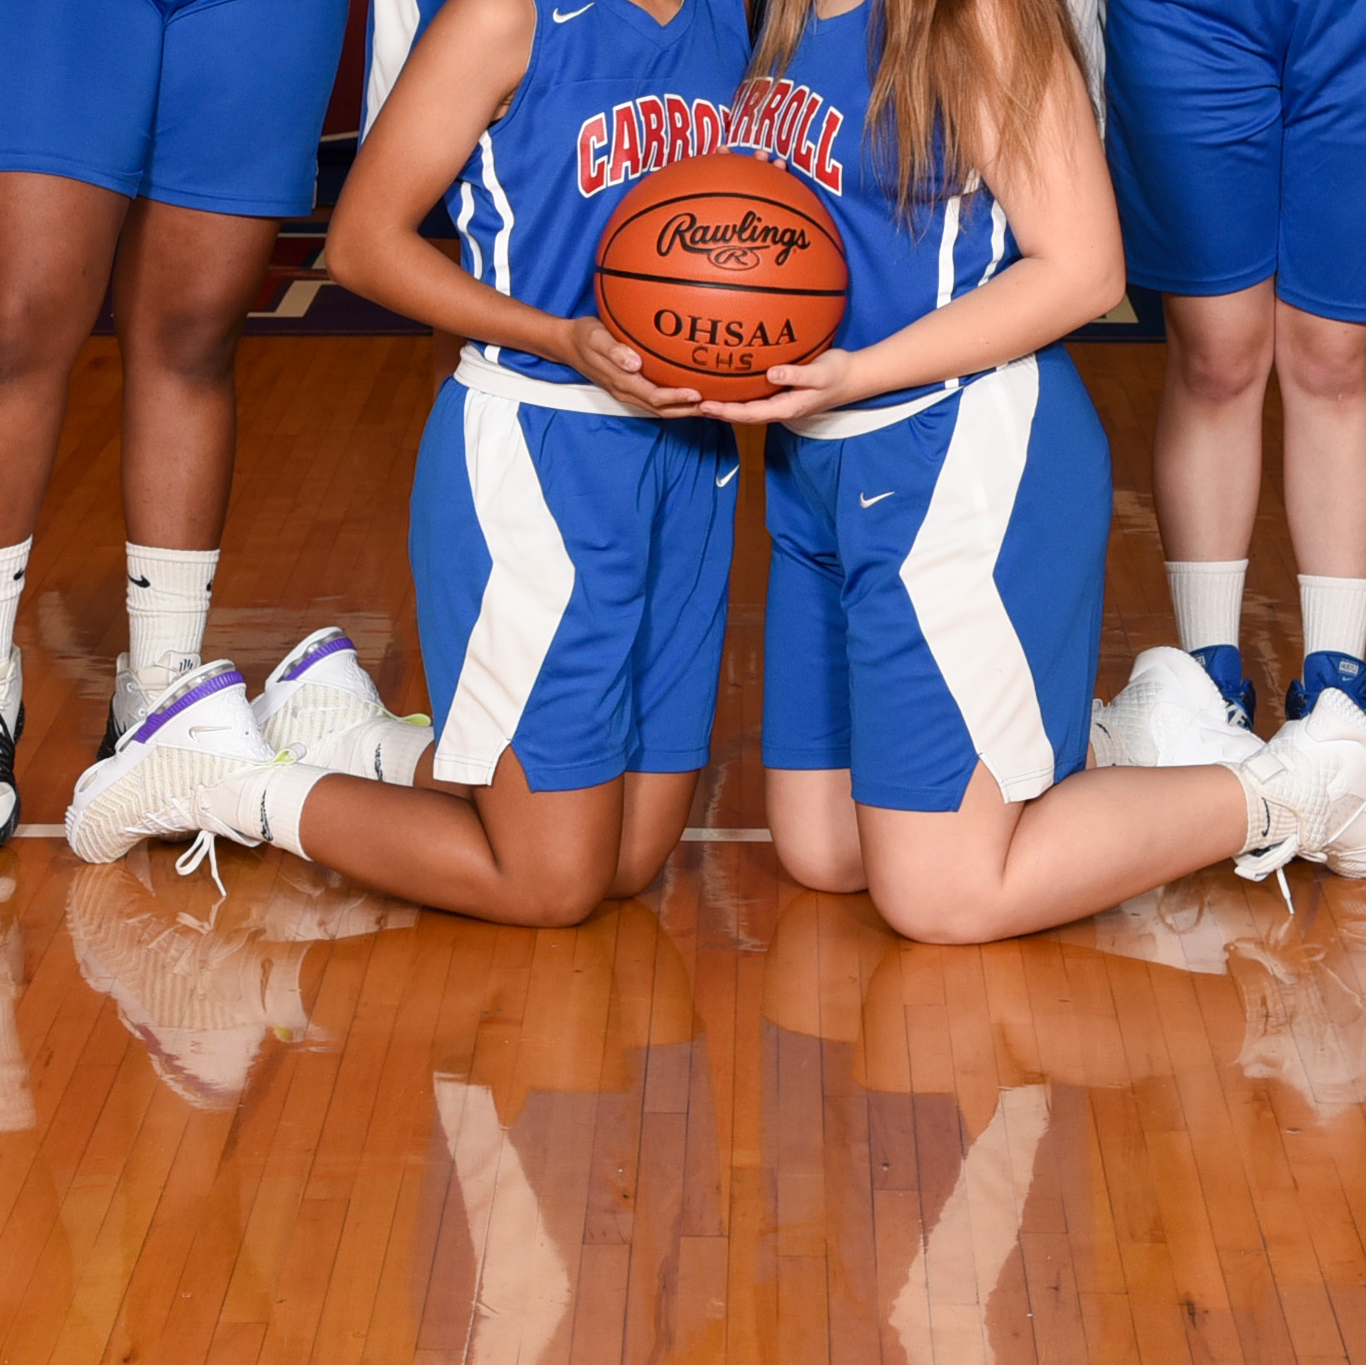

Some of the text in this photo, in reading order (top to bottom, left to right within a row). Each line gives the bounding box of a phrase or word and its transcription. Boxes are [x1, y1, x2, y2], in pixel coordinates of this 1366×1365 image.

[656, 211, 810, 266] Rawlings
[653, 309, 798, 347] OHSAA
[691, 346, 754, 370] CHS
